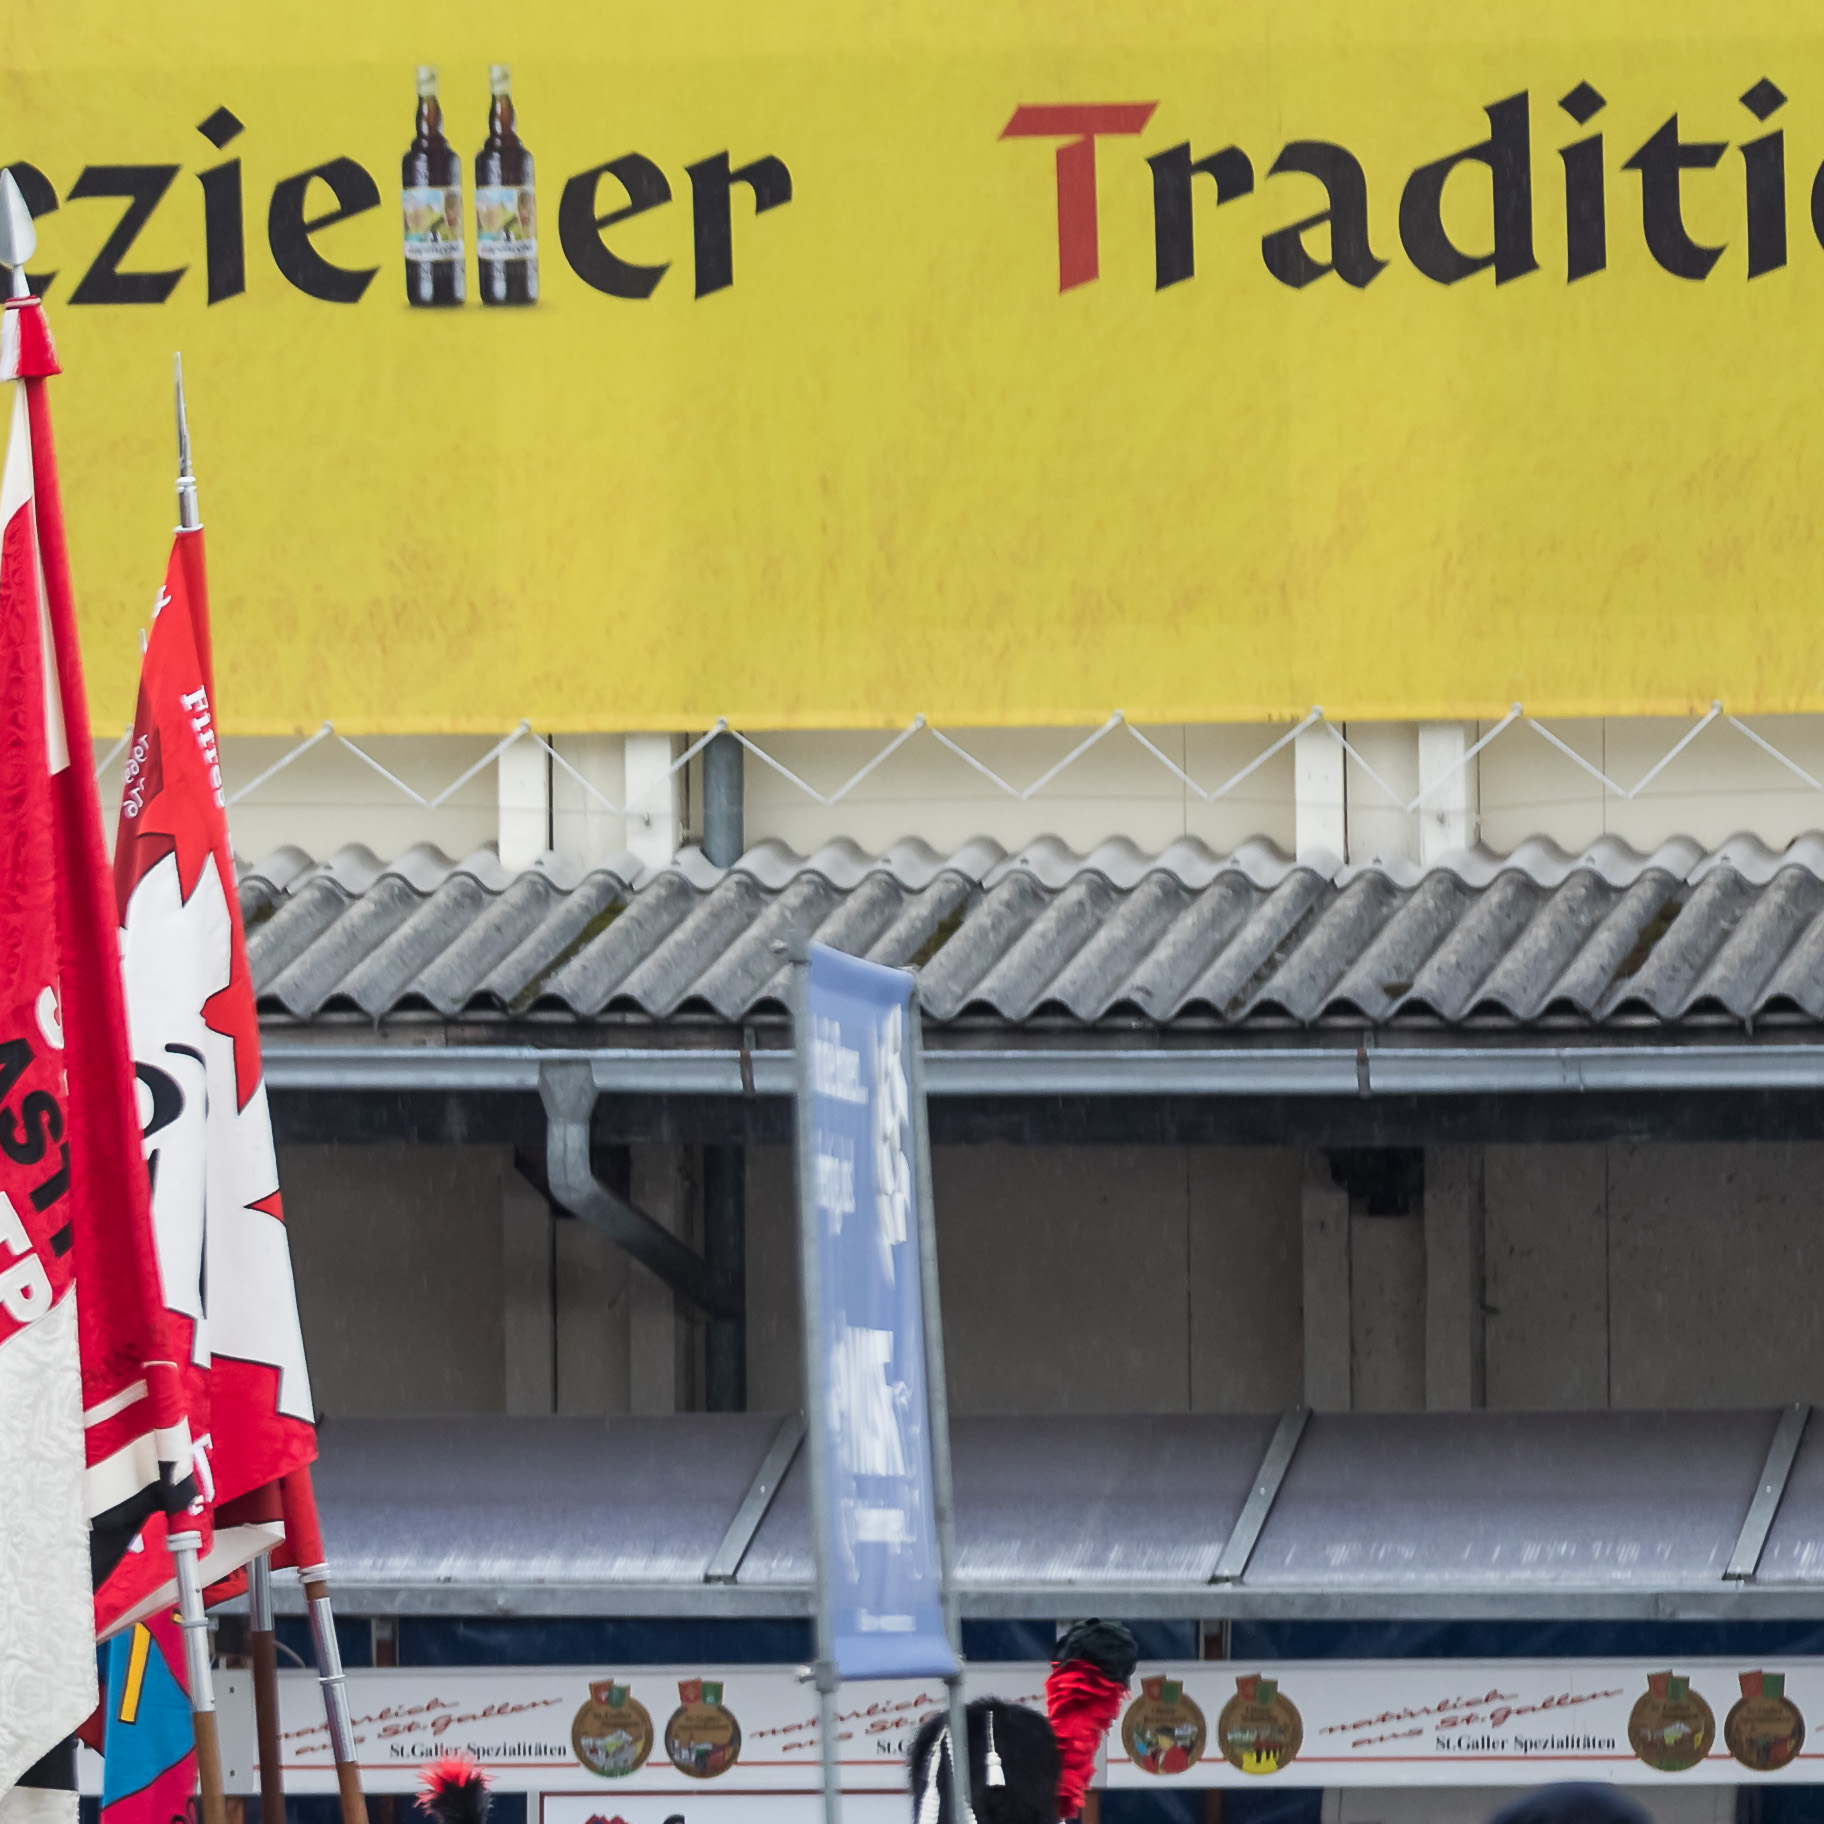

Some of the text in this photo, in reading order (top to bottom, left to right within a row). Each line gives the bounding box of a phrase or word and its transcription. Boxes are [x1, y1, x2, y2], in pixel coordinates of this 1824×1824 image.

[997, 76, 1824, 295] Traditi
[468, 1741, 567, 1762] Spezialitäten
[1435, 1734, 1617, 1755] St.Galler Spezialitäten
